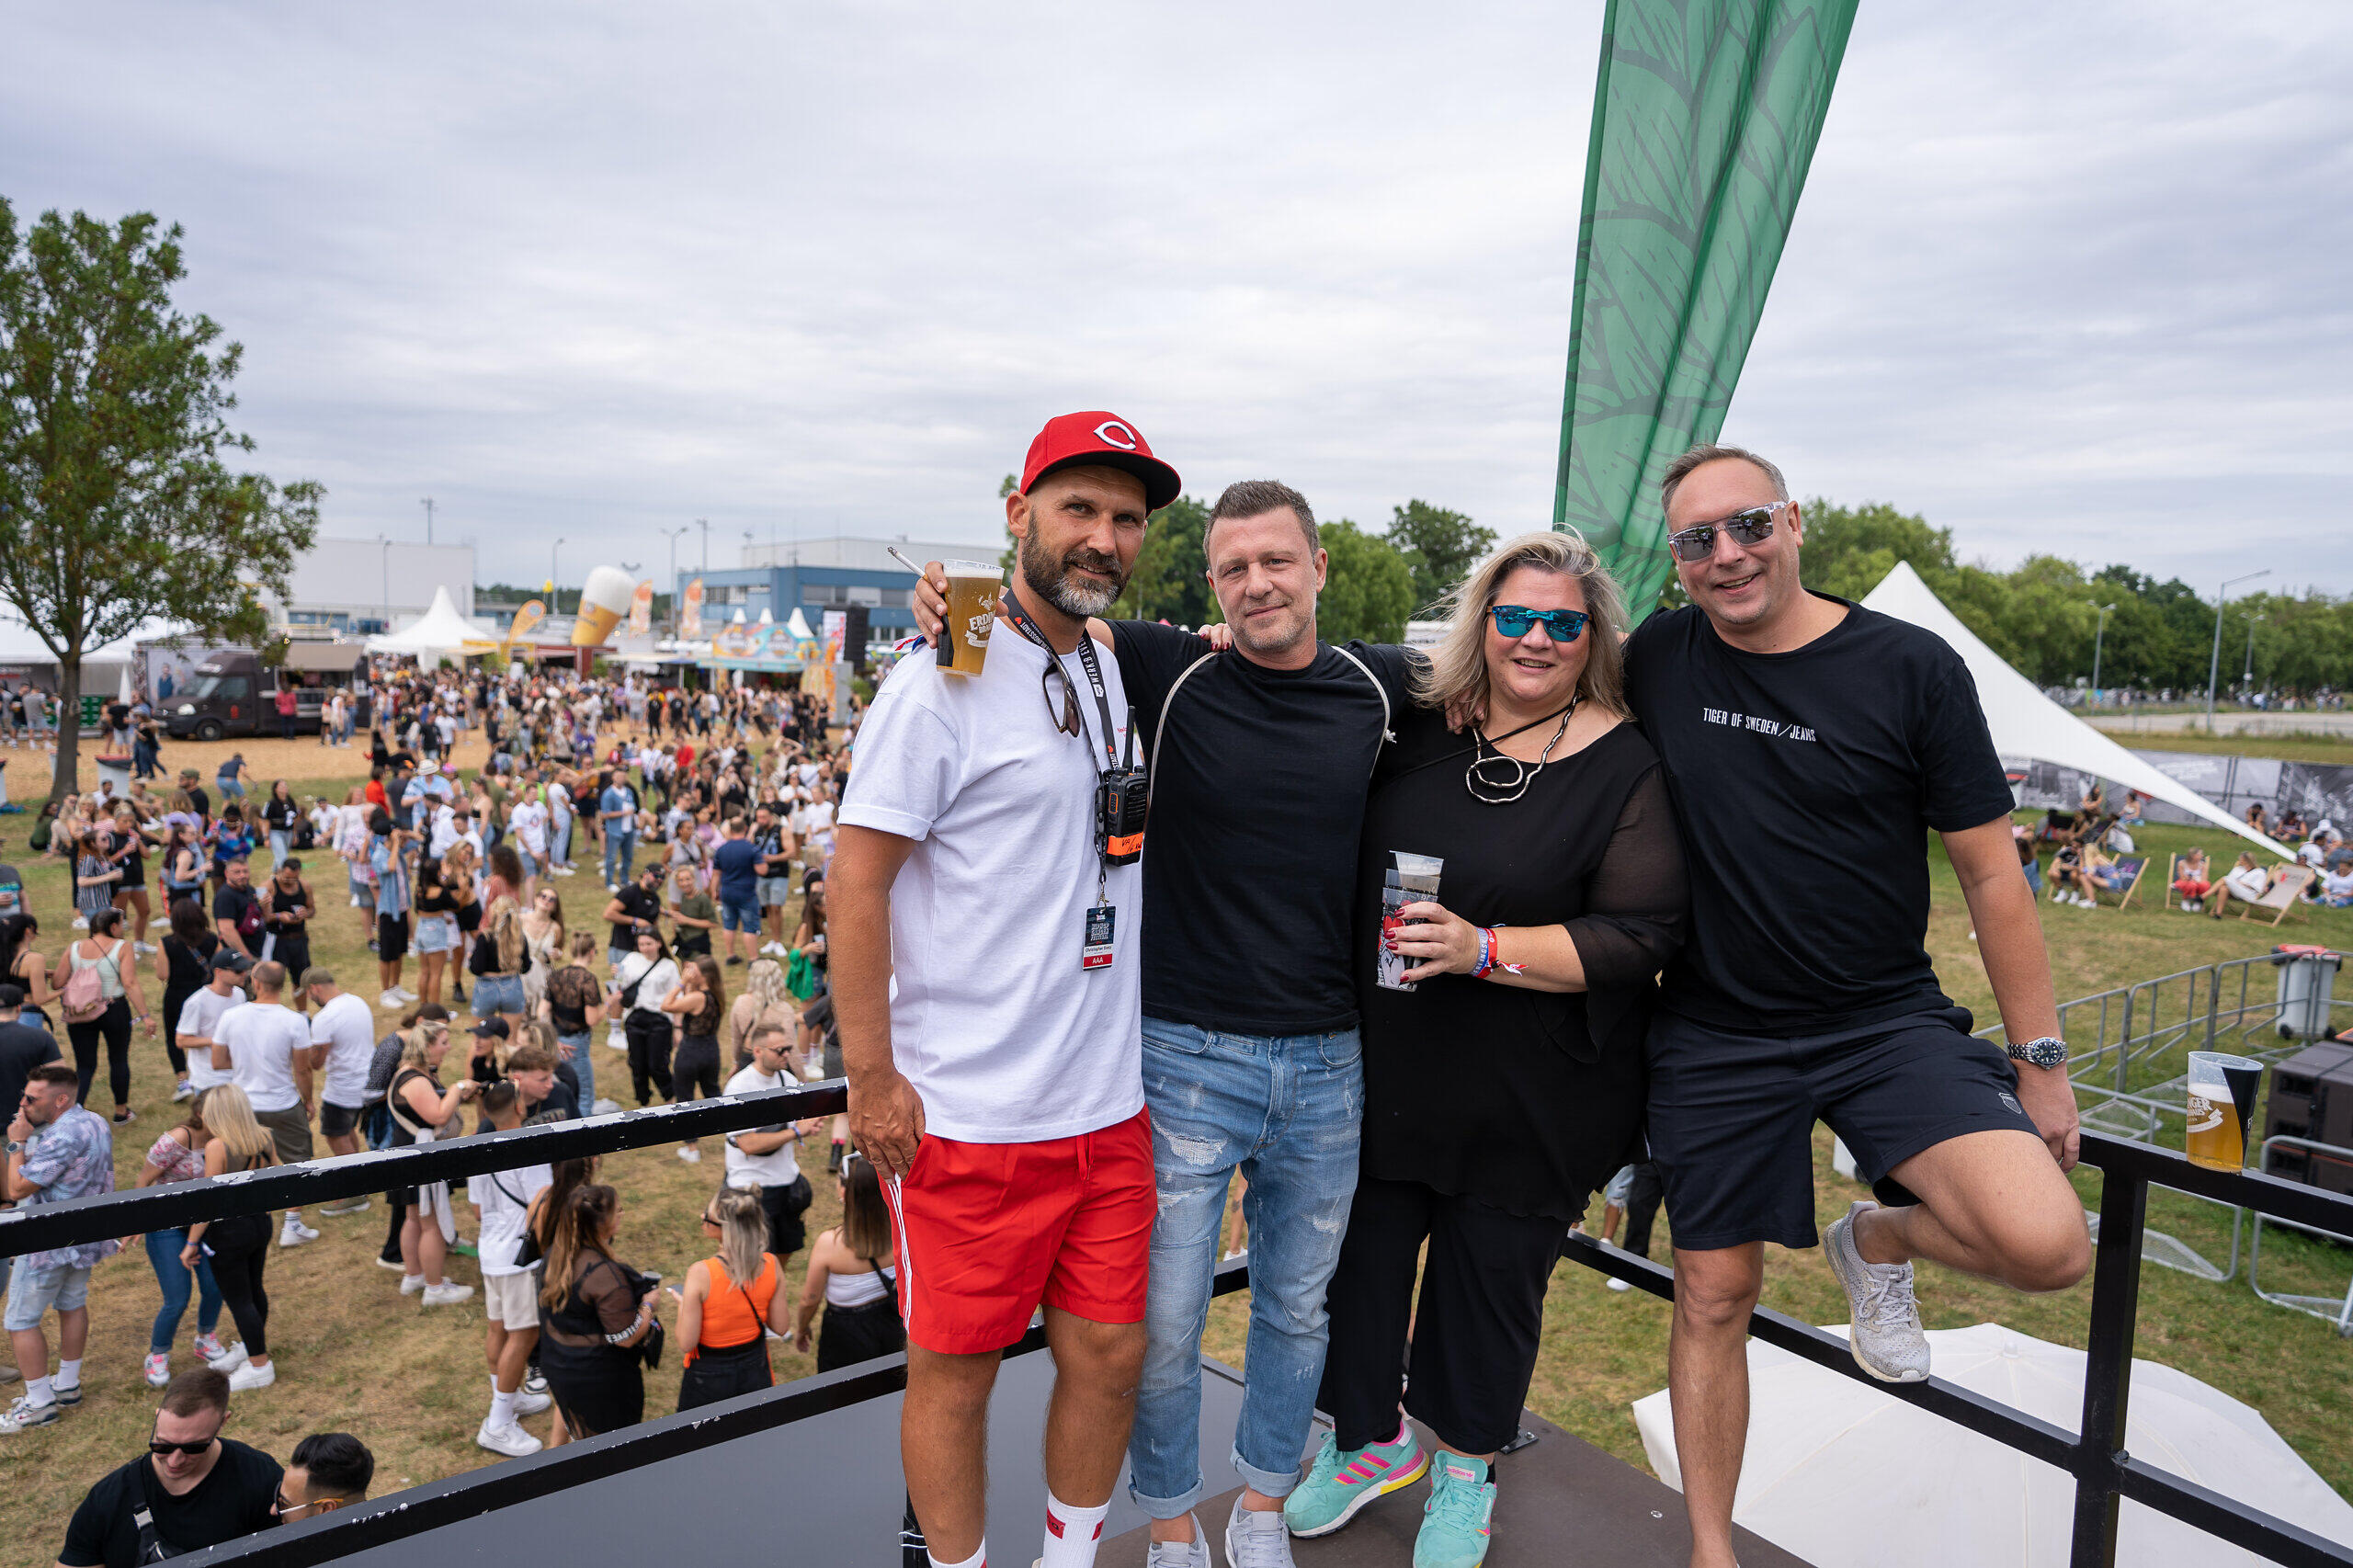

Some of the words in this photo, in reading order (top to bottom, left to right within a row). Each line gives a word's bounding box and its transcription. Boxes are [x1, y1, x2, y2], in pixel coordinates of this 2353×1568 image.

[1093, 420, 1136, 450] C
[1703, 708, 1728, 724] TIGER
[1731, 712, 1743, 728] OF
